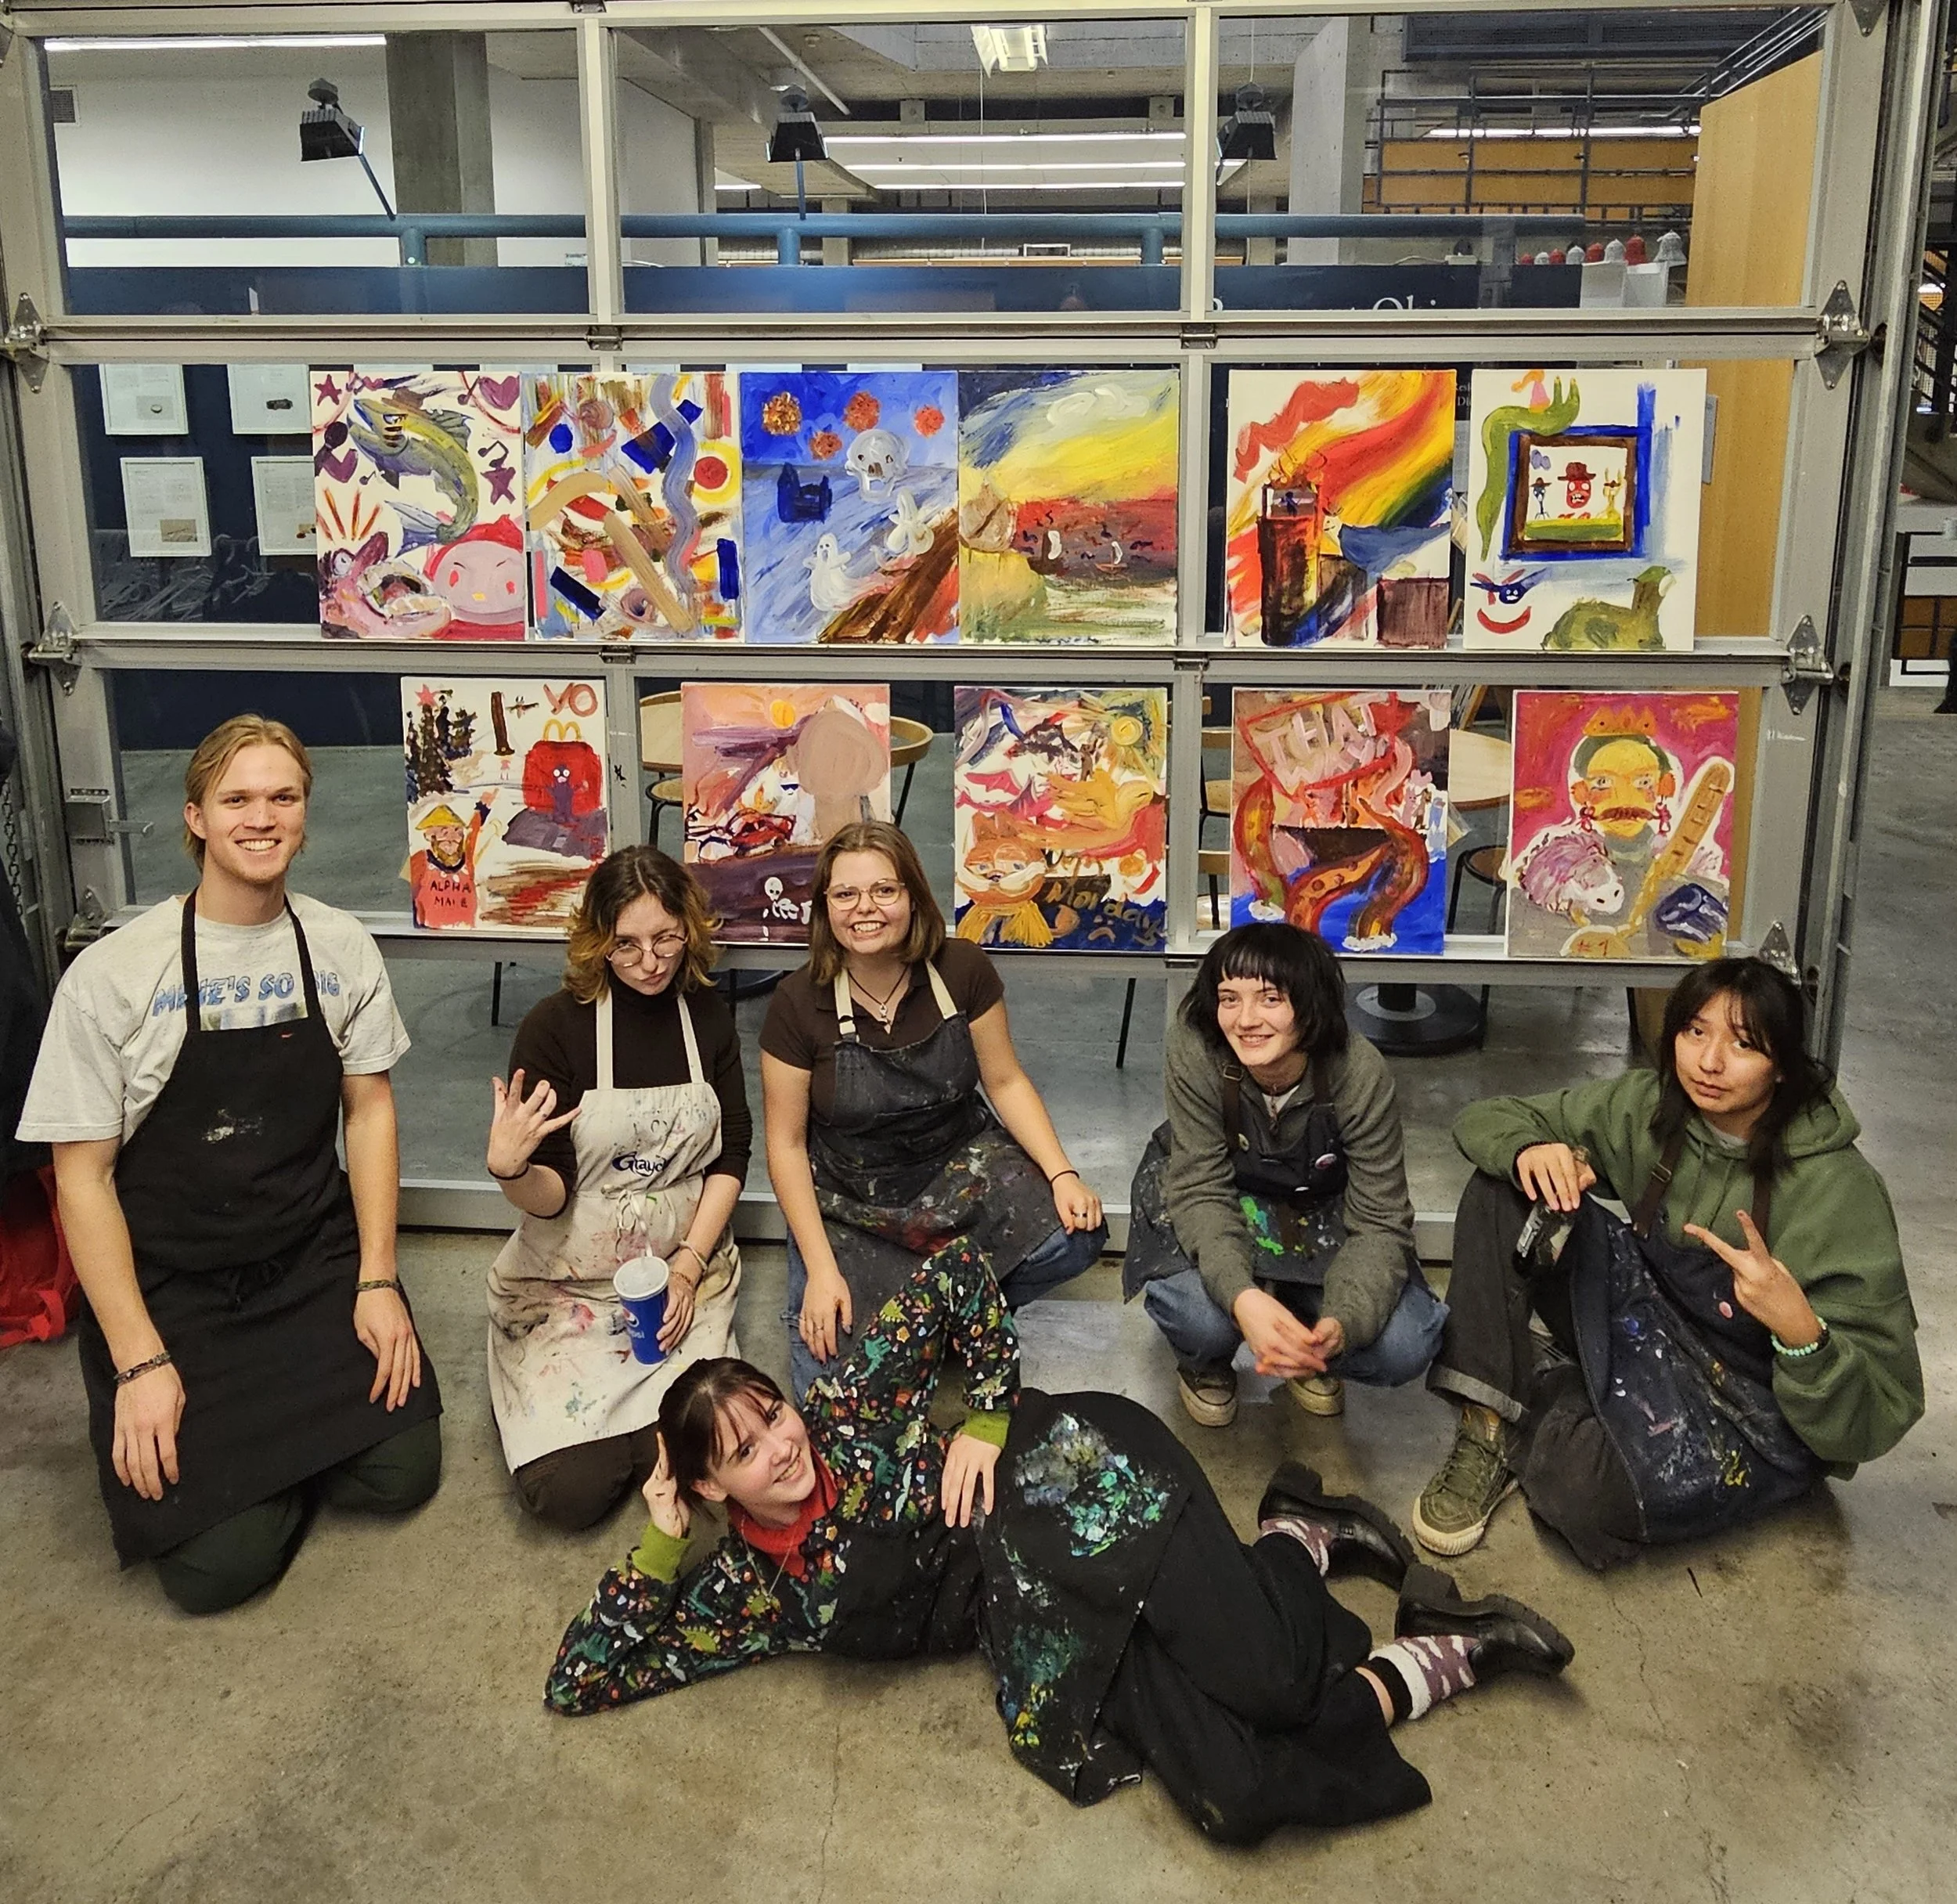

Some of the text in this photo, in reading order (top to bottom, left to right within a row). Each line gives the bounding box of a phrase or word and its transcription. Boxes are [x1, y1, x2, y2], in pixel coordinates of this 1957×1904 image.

[543, 683, 598, 717] YO
[1252, 692, 1386, 766] THAT
[430, 879, 471, 894] ALPHA
[258, 972, 294, 1001] SO
